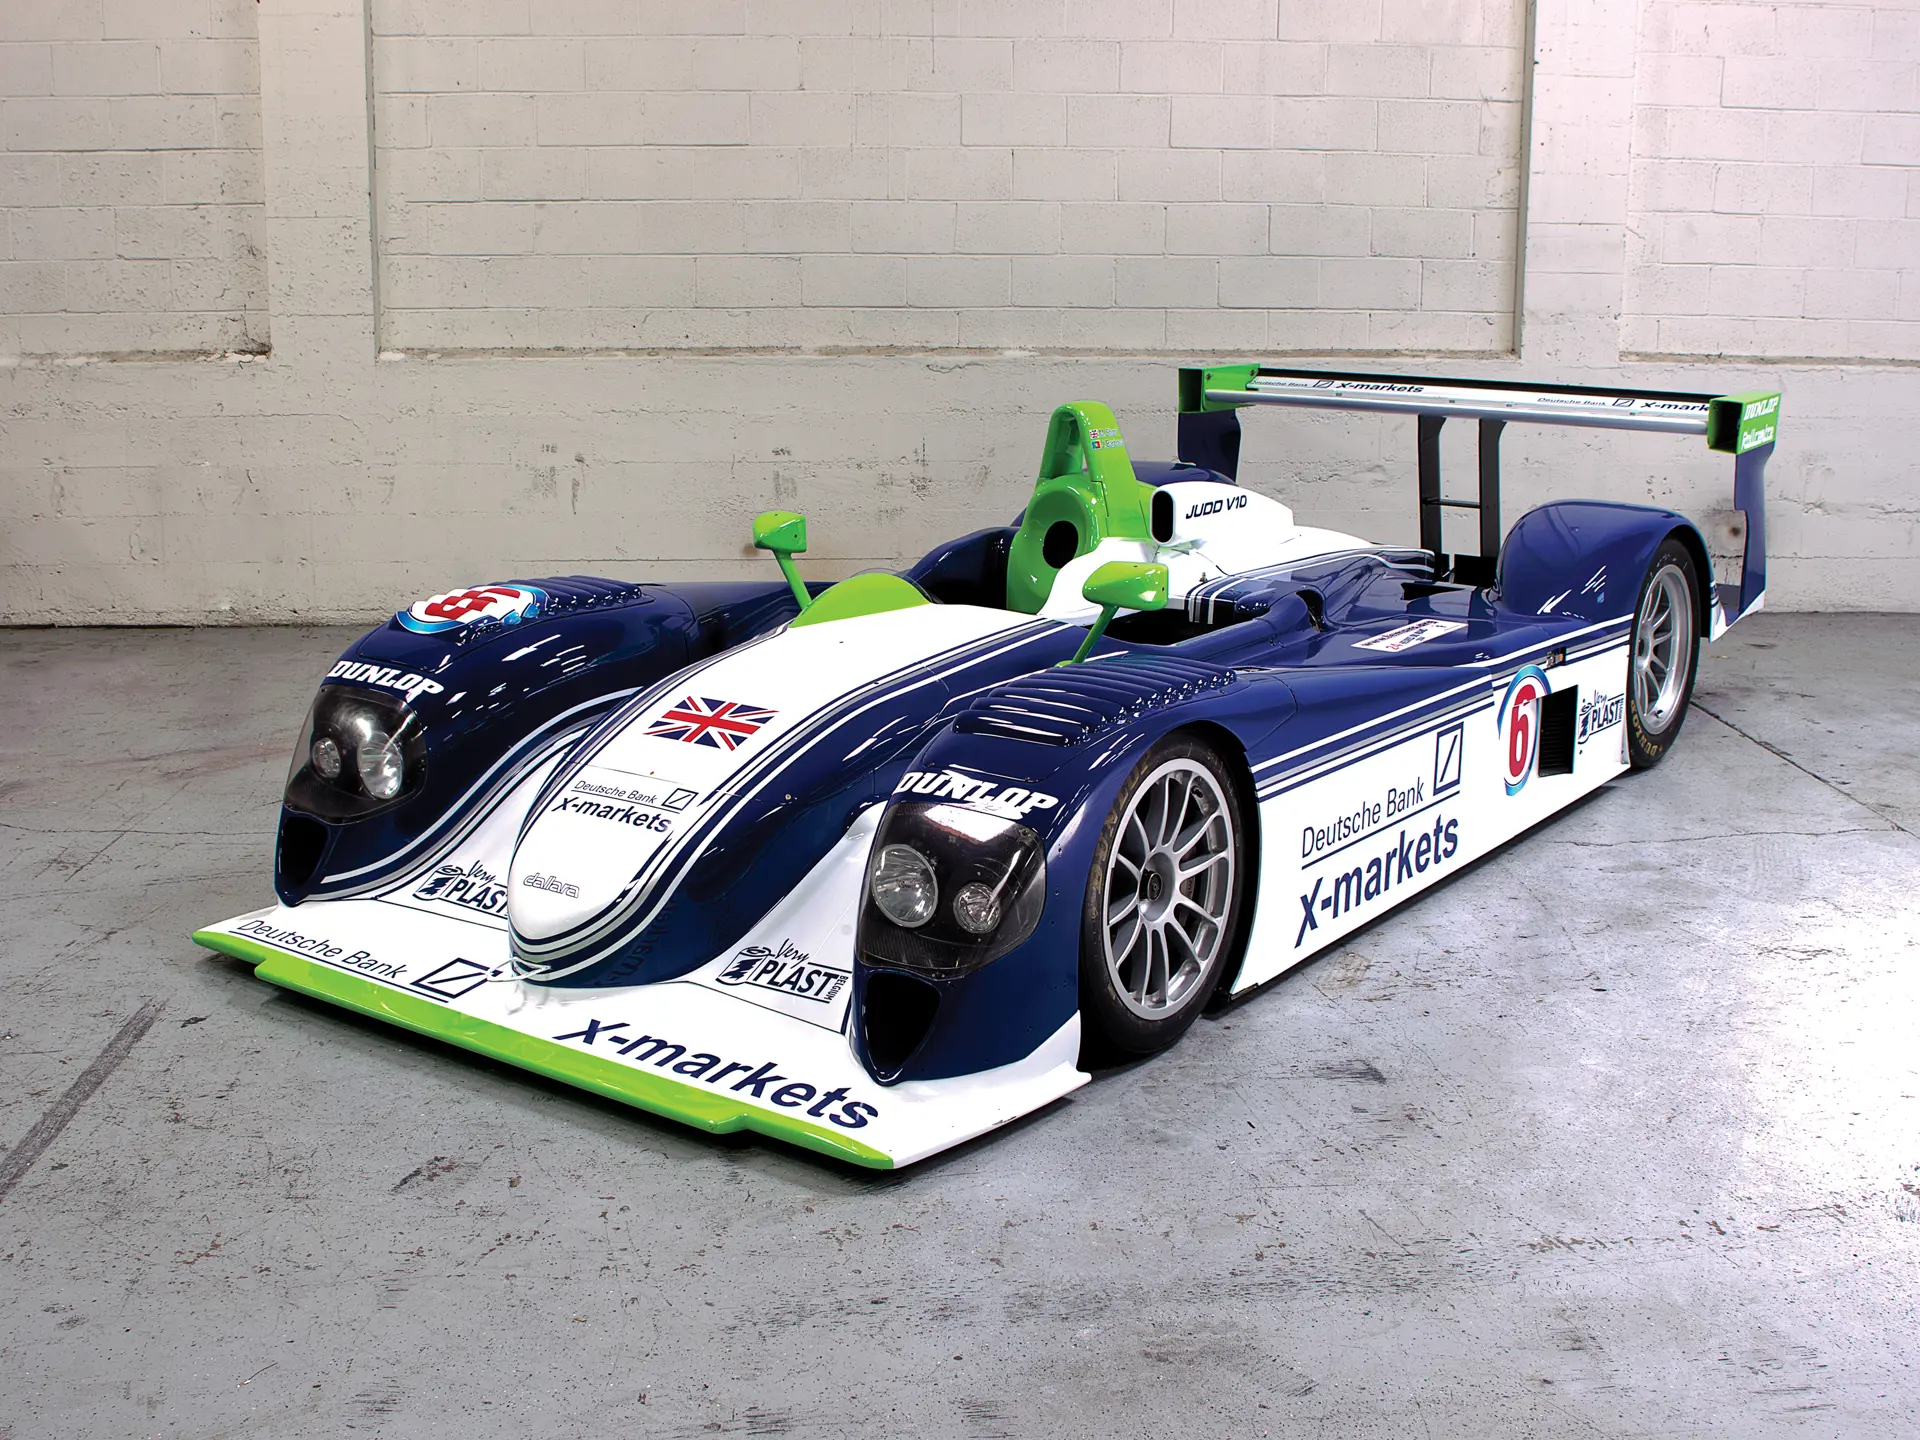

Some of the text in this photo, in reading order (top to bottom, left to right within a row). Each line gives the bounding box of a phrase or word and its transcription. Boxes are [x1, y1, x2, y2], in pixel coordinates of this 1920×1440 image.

[1743, 396, 1779, 420] DUNLOP
[1185, 495, 1247, 519] JUDD V10
[327, 661, 444, 696] DUNLOP
[1509, 684, 1536, 777] 6
[1591, 700, 1620, 731] PLAST
[574, 780, 657, 804] Deutsche Bank
[892, 770, 1059, 814] DUNLOP
[1302, 776, 1424, 858] Deutsche Bank
[466, 860, 496, 888] Very
[523, 872, 579, 898] dallara
[237, 920, 408, 980] Deutsche Bank
[775, 938, 810, 969] Very
[753, 960, 840, 996] PLAST
[824, 975, 849, 1001] BELGIUM
